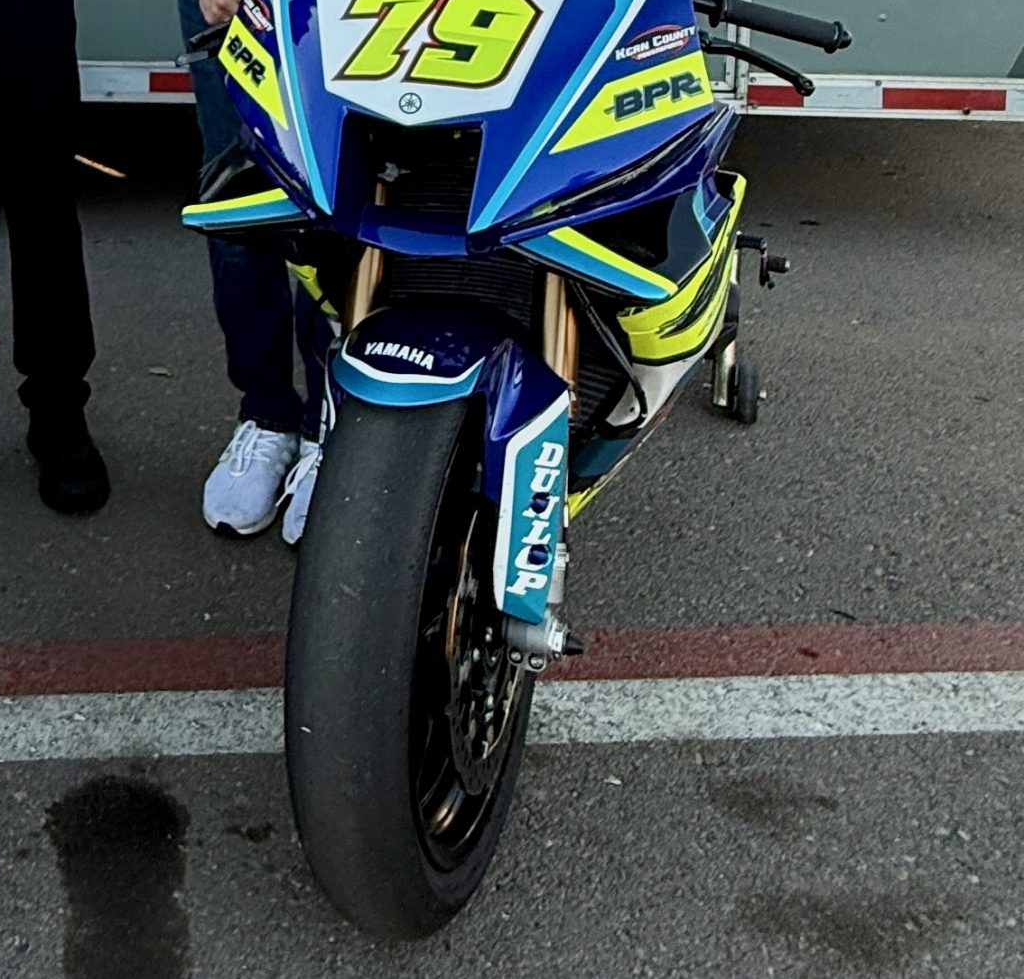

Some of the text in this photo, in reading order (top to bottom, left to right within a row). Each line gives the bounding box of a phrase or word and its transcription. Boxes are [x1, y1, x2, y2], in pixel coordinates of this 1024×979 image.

[226, 34, 266, 89] BPR
[603, 71, 705, 122] BPR
[364, 341, 434, 370] YAMAHA
